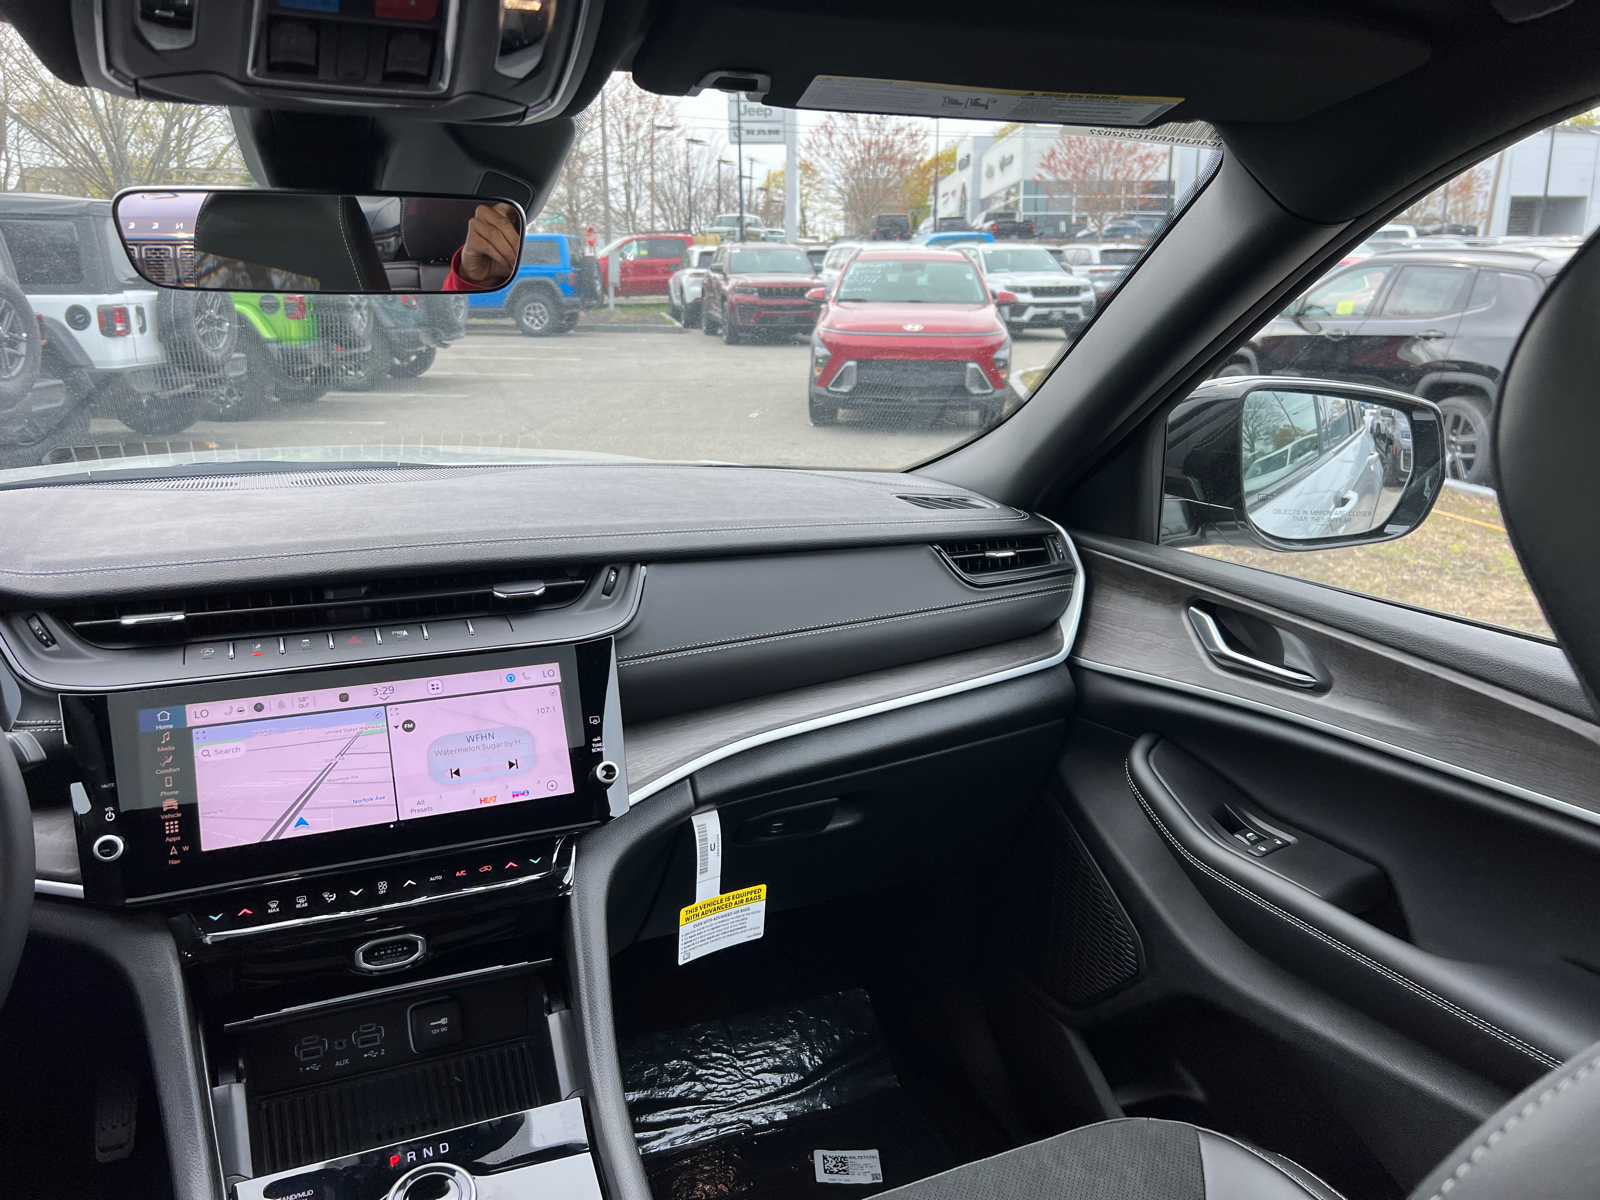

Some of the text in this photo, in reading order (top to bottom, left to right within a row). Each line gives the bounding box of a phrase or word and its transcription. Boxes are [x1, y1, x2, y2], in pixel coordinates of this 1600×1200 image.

[739, 103, 773, 119] Jeep
[745, 128, 781, 136] RAM
[541, 668, 556, 679] LO
[372, 685, 395, 697] 3:29
[194, 709, 210, 719] LO
[536, 706, 557, 715] 107.1
[155, 723, 174, 731] Home
[324, 727, 342, 735] United
[343, 726, 358, 734] States
[403, 722, 414, 730] FM
[465, 731, 496, 743] WFHN
[214, 746, 241, 756] Search
[434, 744, 481, 757] Watermelon
[481, 741, 504, 752] Sugar
[504, 740, 514, 748] by
[155, 767, 181, 775] Comfort
[160, 789, 180, 797] Phone
[352, 794, 386, 805] Norfolk Ave
[479, 795, 498, 805] HEAT
[410, 805, 434, 815] Presets
[160, 811, 182, 820] Vehicle
[165, 835, 181, 844] Apps
[710, 842, 716, 852] U
[168, 858, 181, 866] Nav
[684, 905, 699, 916] THIS
[698, 898, 724, 910] VEHICLE
[731, 888, 762, 900] EQUIPPED
[267, 906, 280, 914] MAX
[684, 912, 700, 923] WITH
[700, 903, 733, 918] ADVANCED
[745, 894, 762, 903] BAGS
[713, 912, 733, 922] ADVANCED
[374, 947, 409, 956] ENGINE
[334, 1058, 350, 1067] AUX
[389, 1142, 450, 1168] P R N D
[281, 1189, 314, 1200] AND/MUD
